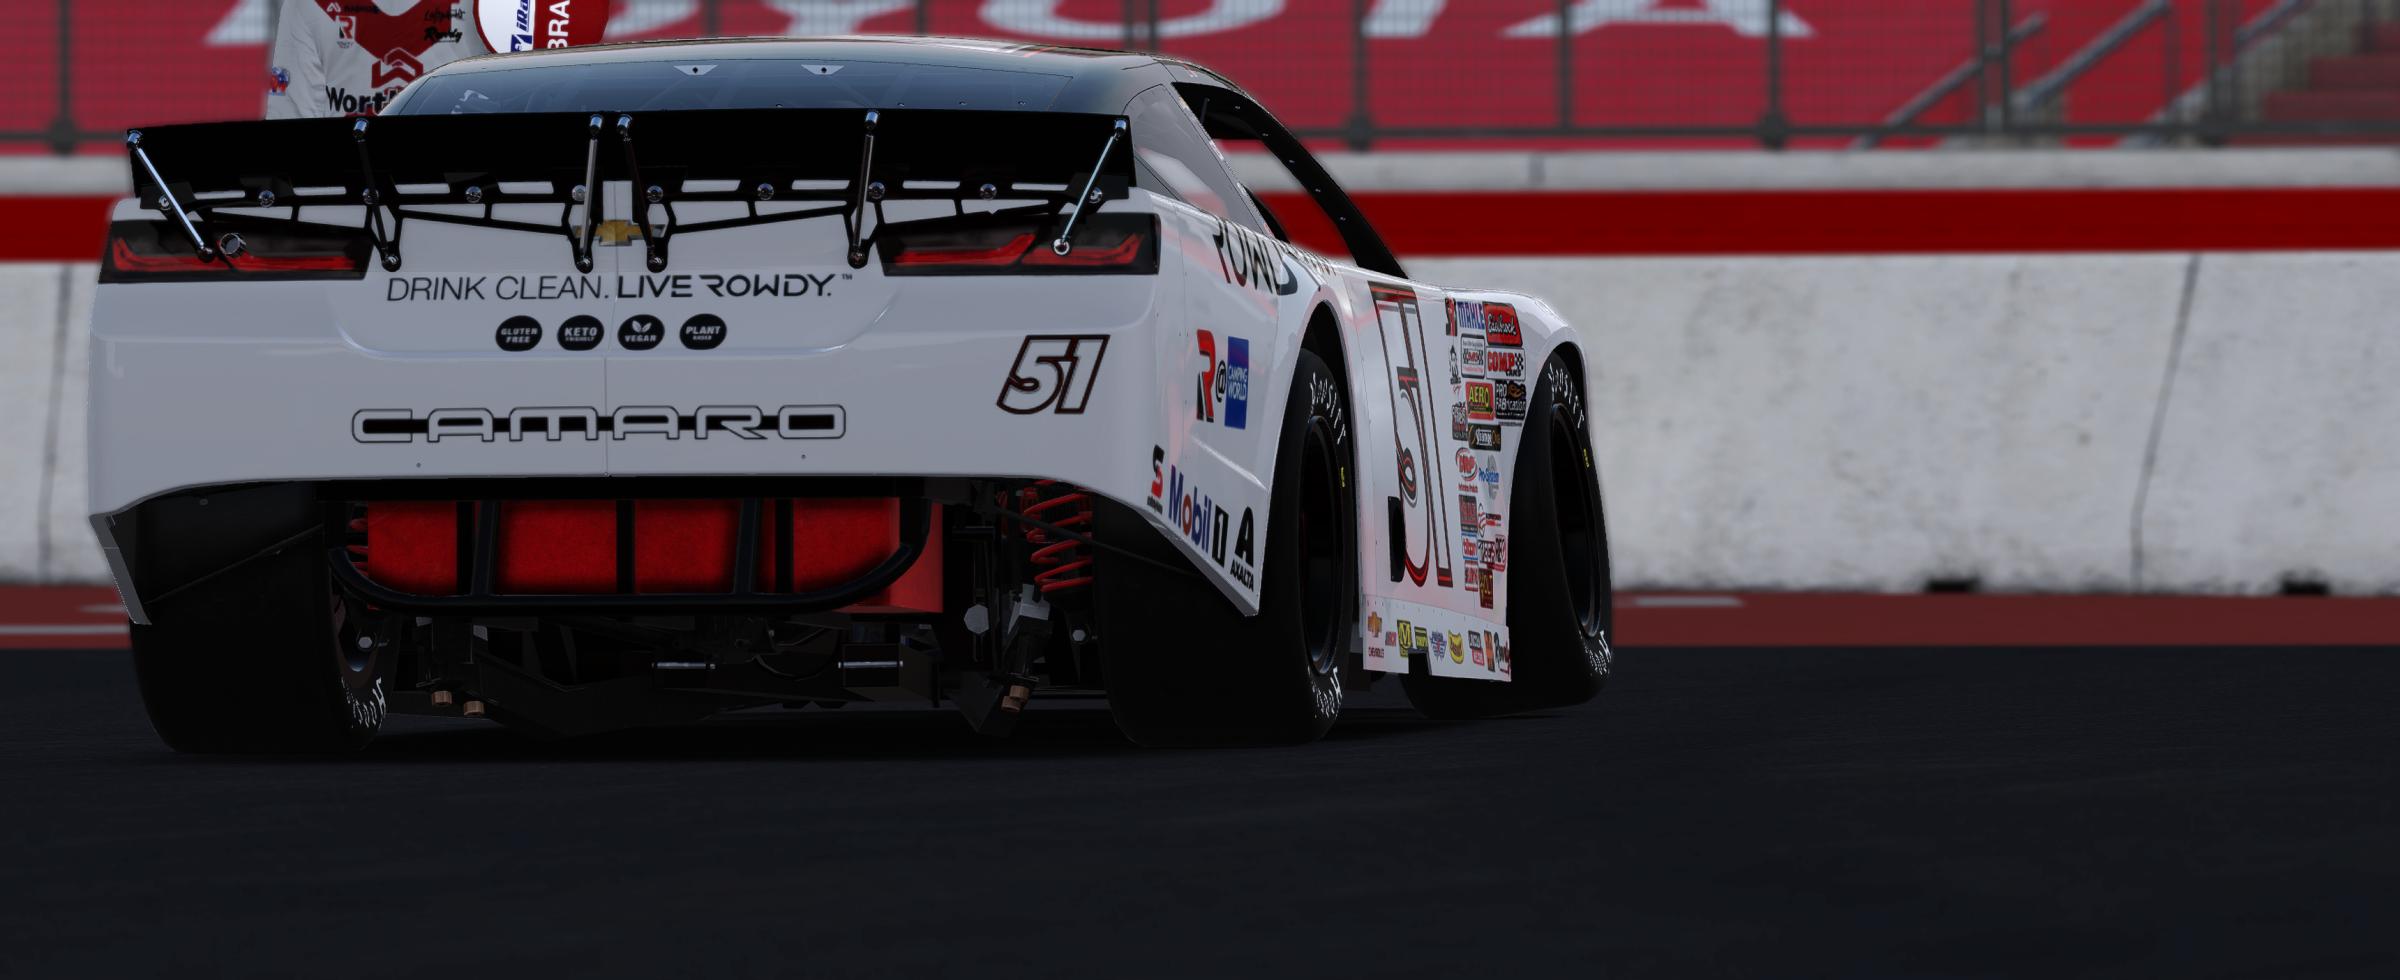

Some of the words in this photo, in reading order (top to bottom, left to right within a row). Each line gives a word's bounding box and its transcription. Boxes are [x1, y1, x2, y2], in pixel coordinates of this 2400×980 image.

[387, 277, 486, 301] DRINK
[496, 276, 609, 300] CLEAN.
[617, 275, 693, 298] LIVE
[699, 274, 835, 298] ROWDY.
[1457, 301, 1485, 329] MAHLE
[564, 327, 598, 336] KETO
[624, 335, 657, 343] VEGAN
[686, 326, 721, 335] PLANT
[1487, 351, 1515, 371] COMP
[997, 335, 1110, 414] 51
[1228, 366, 1247, 381] CAMPING
[1228, 382, 1247, 401] WORLD
[1469, 385, 1490, 407] AERO
[1496, 383, 1507, 398] PRO
[352, 405, 846, 443] CAMARO
[1367, 281, 1453, 587] 51
[1169, 464, 1212, 554] Mobil
[1230, 559, 1254, 592] AXALTA
